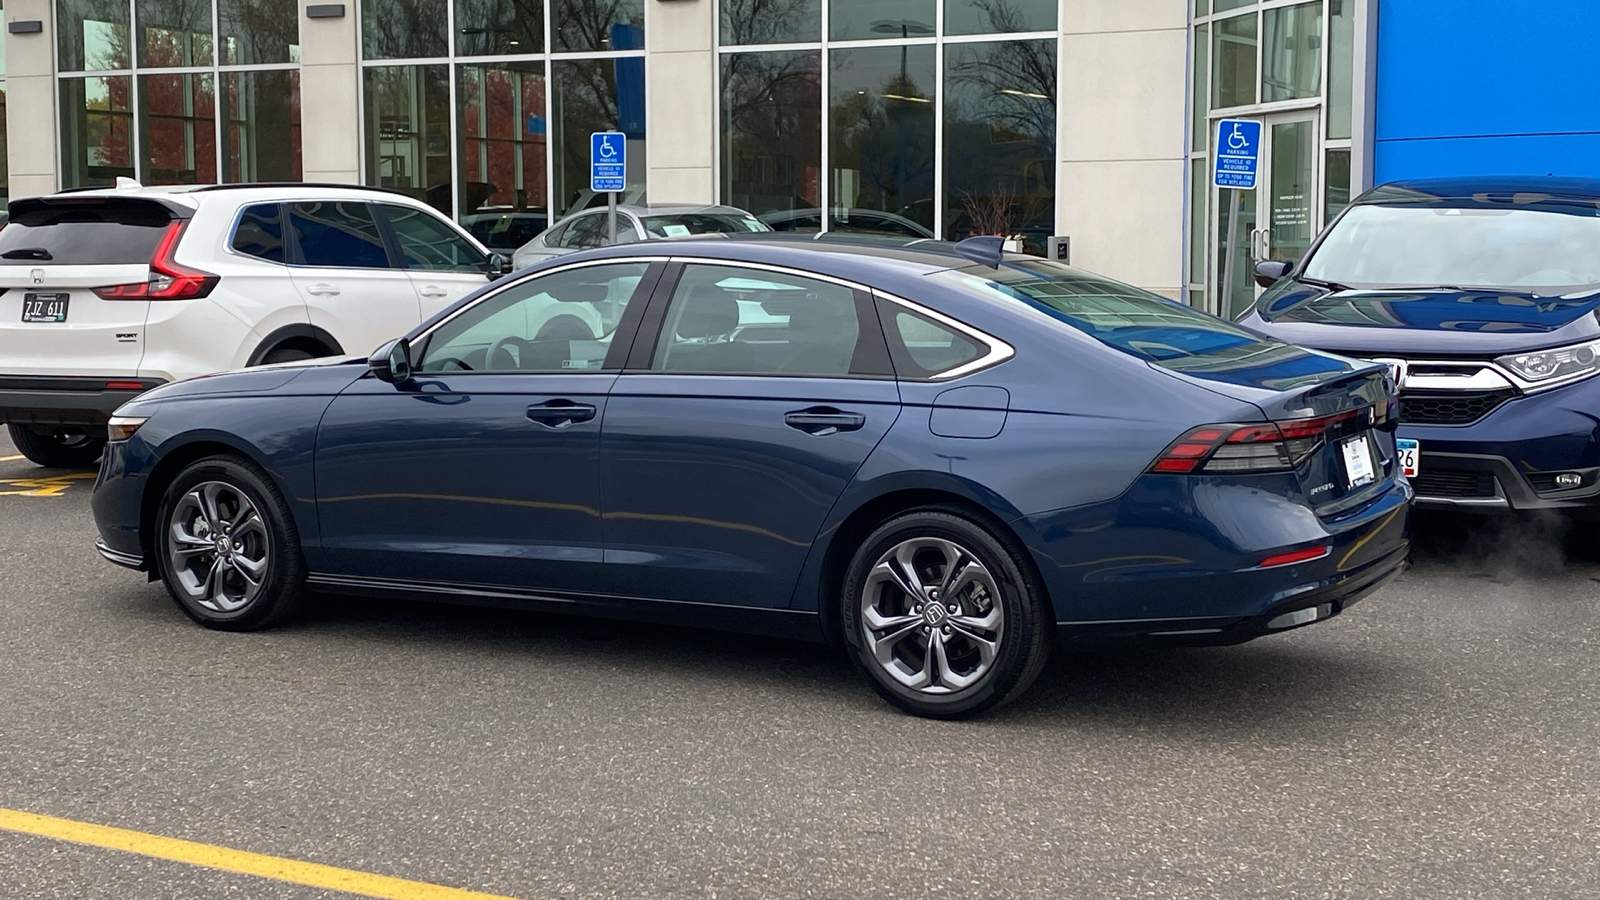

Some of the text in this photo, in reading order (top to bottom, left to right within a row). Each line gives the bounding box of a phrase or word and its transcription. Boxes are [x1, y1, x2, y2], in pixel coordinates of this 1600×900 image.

[25, 301, 64, 316] ZJZ 611
[843, 576, 857, 630] KINERGY
